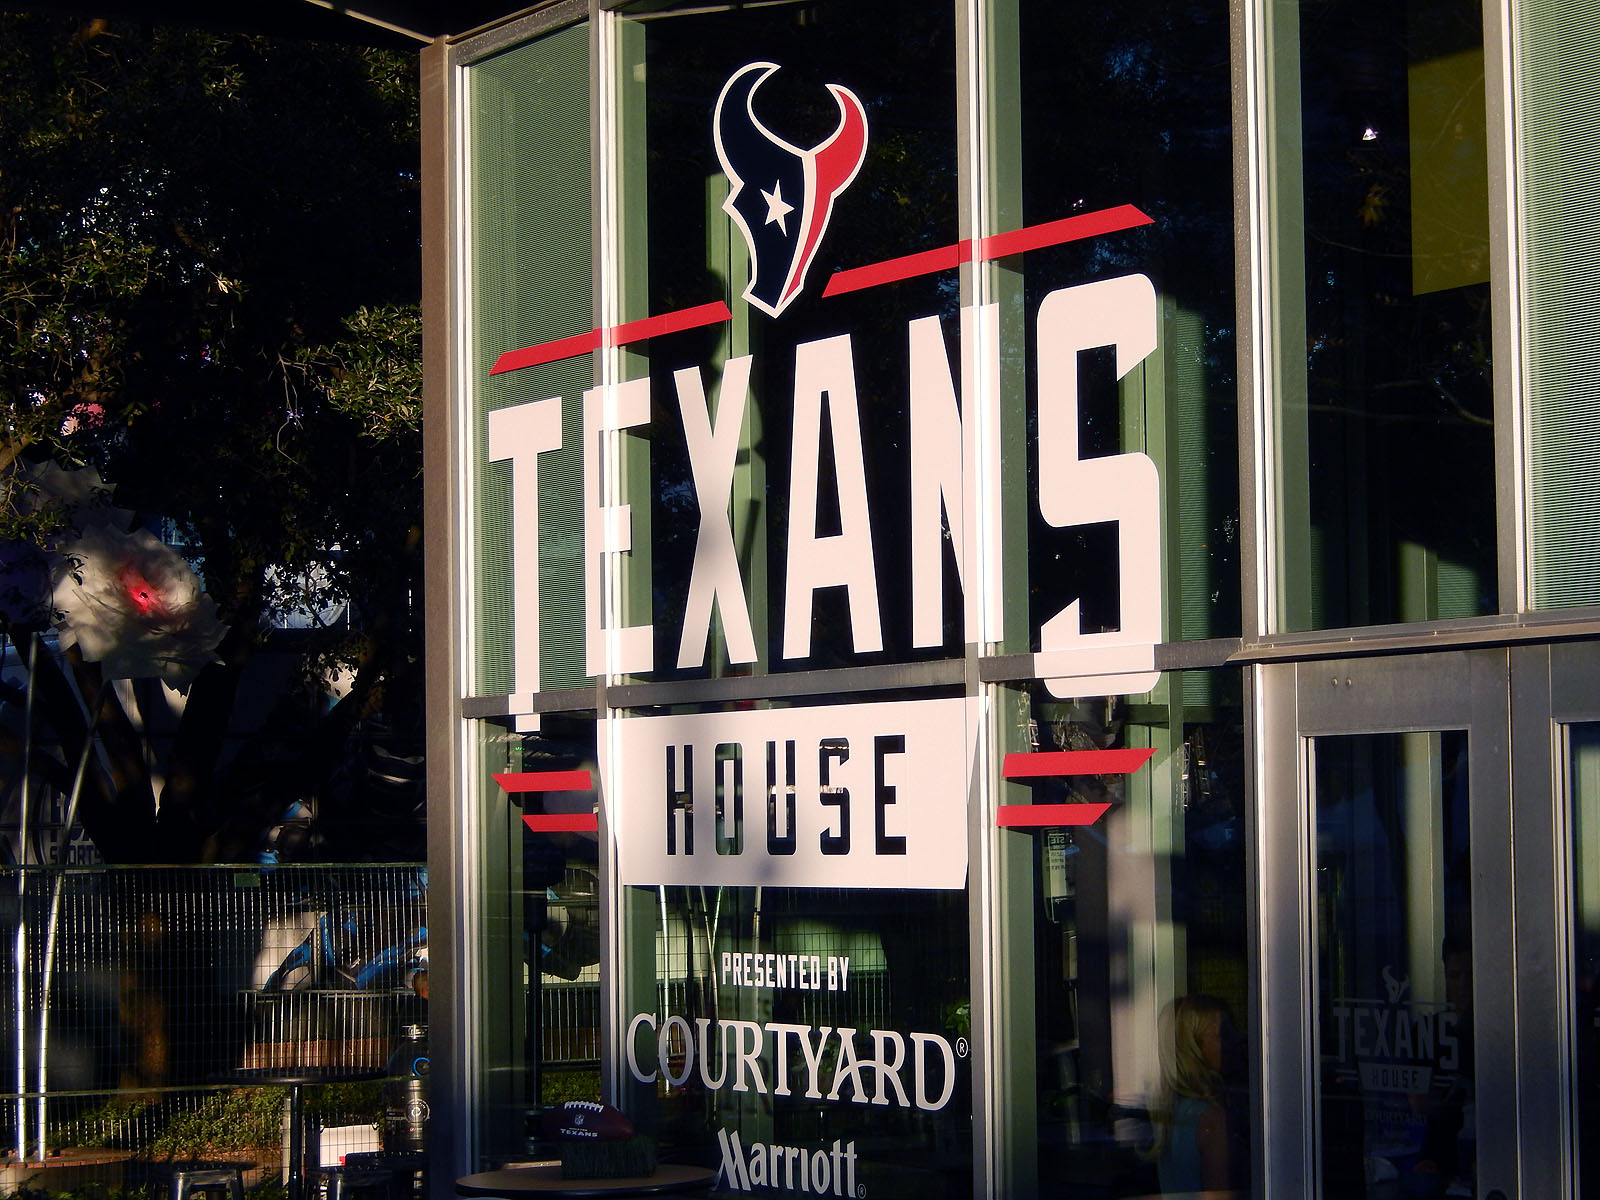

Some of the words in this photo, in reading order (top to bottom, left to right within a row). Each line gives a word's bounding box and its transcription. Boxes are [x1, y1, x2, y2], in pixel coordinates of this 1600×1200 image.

[488, 272, 1162, 732] TEXANS
[666, 734, 907, 856] HOUSE
[722, 951, 820, 990] PRESENTED
[827, 956, 850, 992] BY
[1332, 1006, 1461, 1072] TEXANS
[560, 1128, 598, 1137] TEXANS
